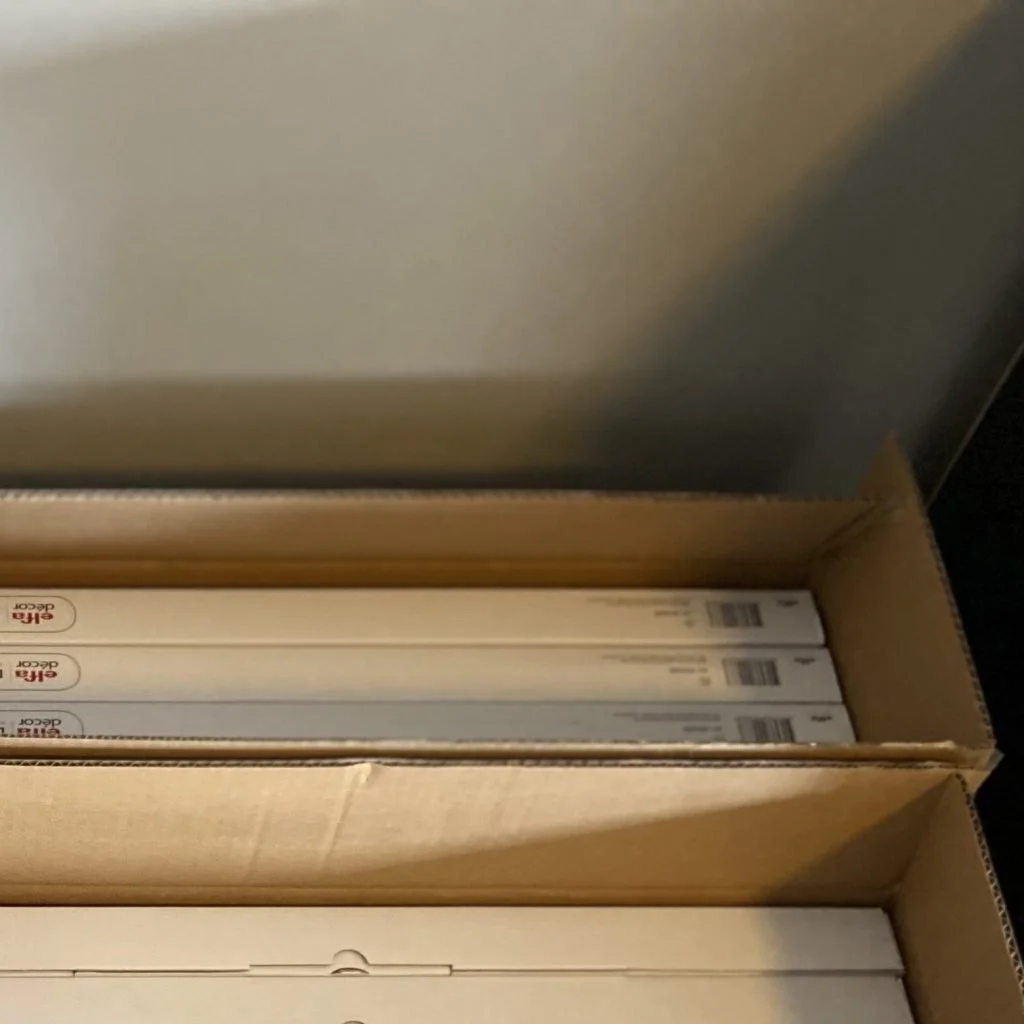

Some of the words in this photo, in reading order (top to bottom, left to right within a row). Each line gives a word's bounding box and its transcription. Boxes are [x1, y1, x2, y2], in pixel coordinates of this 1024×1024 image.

[13, 602, 55, 612] décor
[12, 612, 54, 624] elfa
[16, 660, 58, 670] décor
[15, 670, 57, 682] elfa
[18, 718, 62, 727] décor
